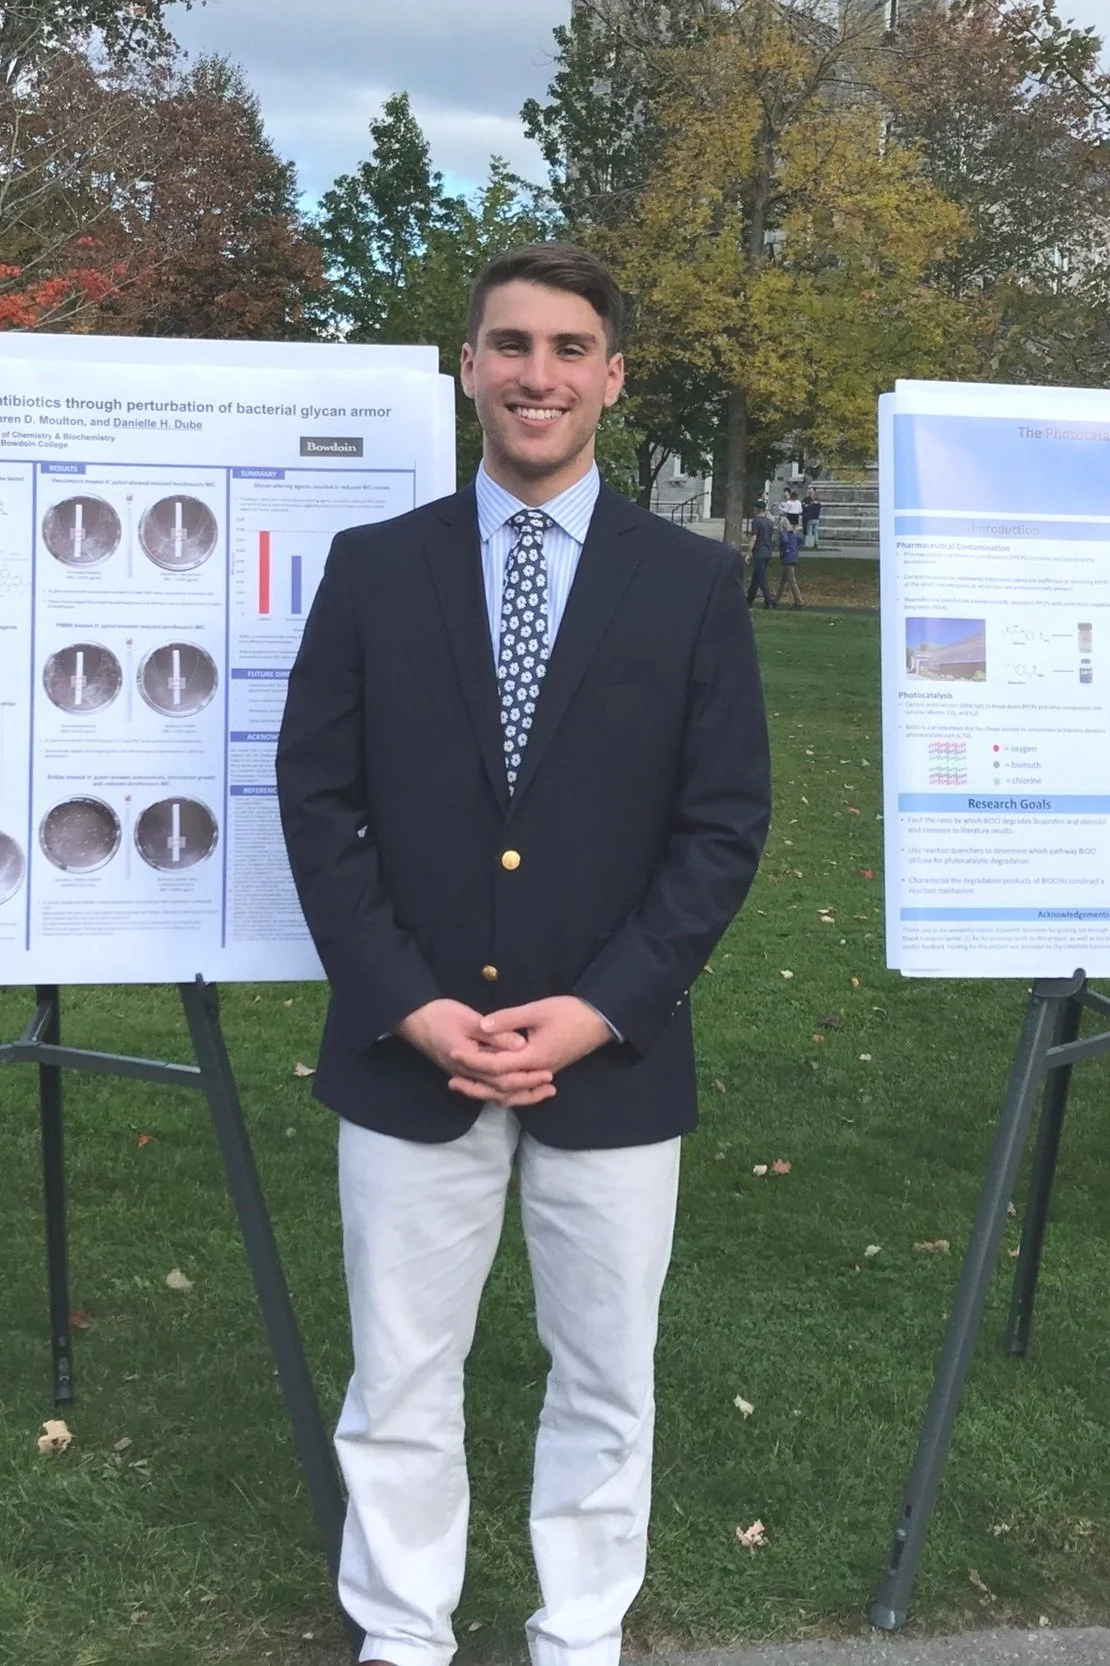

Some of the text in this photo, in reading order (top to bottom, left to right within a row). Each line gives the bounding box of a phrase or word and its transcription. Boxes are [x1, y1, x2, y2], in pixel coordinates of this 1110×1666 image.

[0, 395, 392, 419] tibiotics through perturbation of bacterial glycan armor
[24, 415, 35, 424] D.
[39, 416, 86, 427] Moulton,
[90, 418, 110, 426] and
[114, 418, 157, 428] Danielle
[174, 419, 203, 430] Dube
[12, 431, 52, 440] Chemistry
[63, 433, 116, 442] Biochemistry
[1018, 426, 1042, 439] The
[38, 440, 69, 449] College
[306, 441, 357, 452] Bowdoin
[49, 465, 78, 473] RESULTS
[241, 470, 278, 478] SUMMARY
[971, 523, 1040, 536] Introduction
[896, 541, 1010, 552] Pharmaceutical Contamination
[898, 691, 953, 700] Photocatalysis
[1010, 745, 1037, 754] oxygen
[1011, 760, 1042, 769] bismuth
[1011, 777, 1042, 785] chlorine
[968, 798, 1052, 809] Research Goals
[1038, 910, 1110, 920] Acknowledgements
